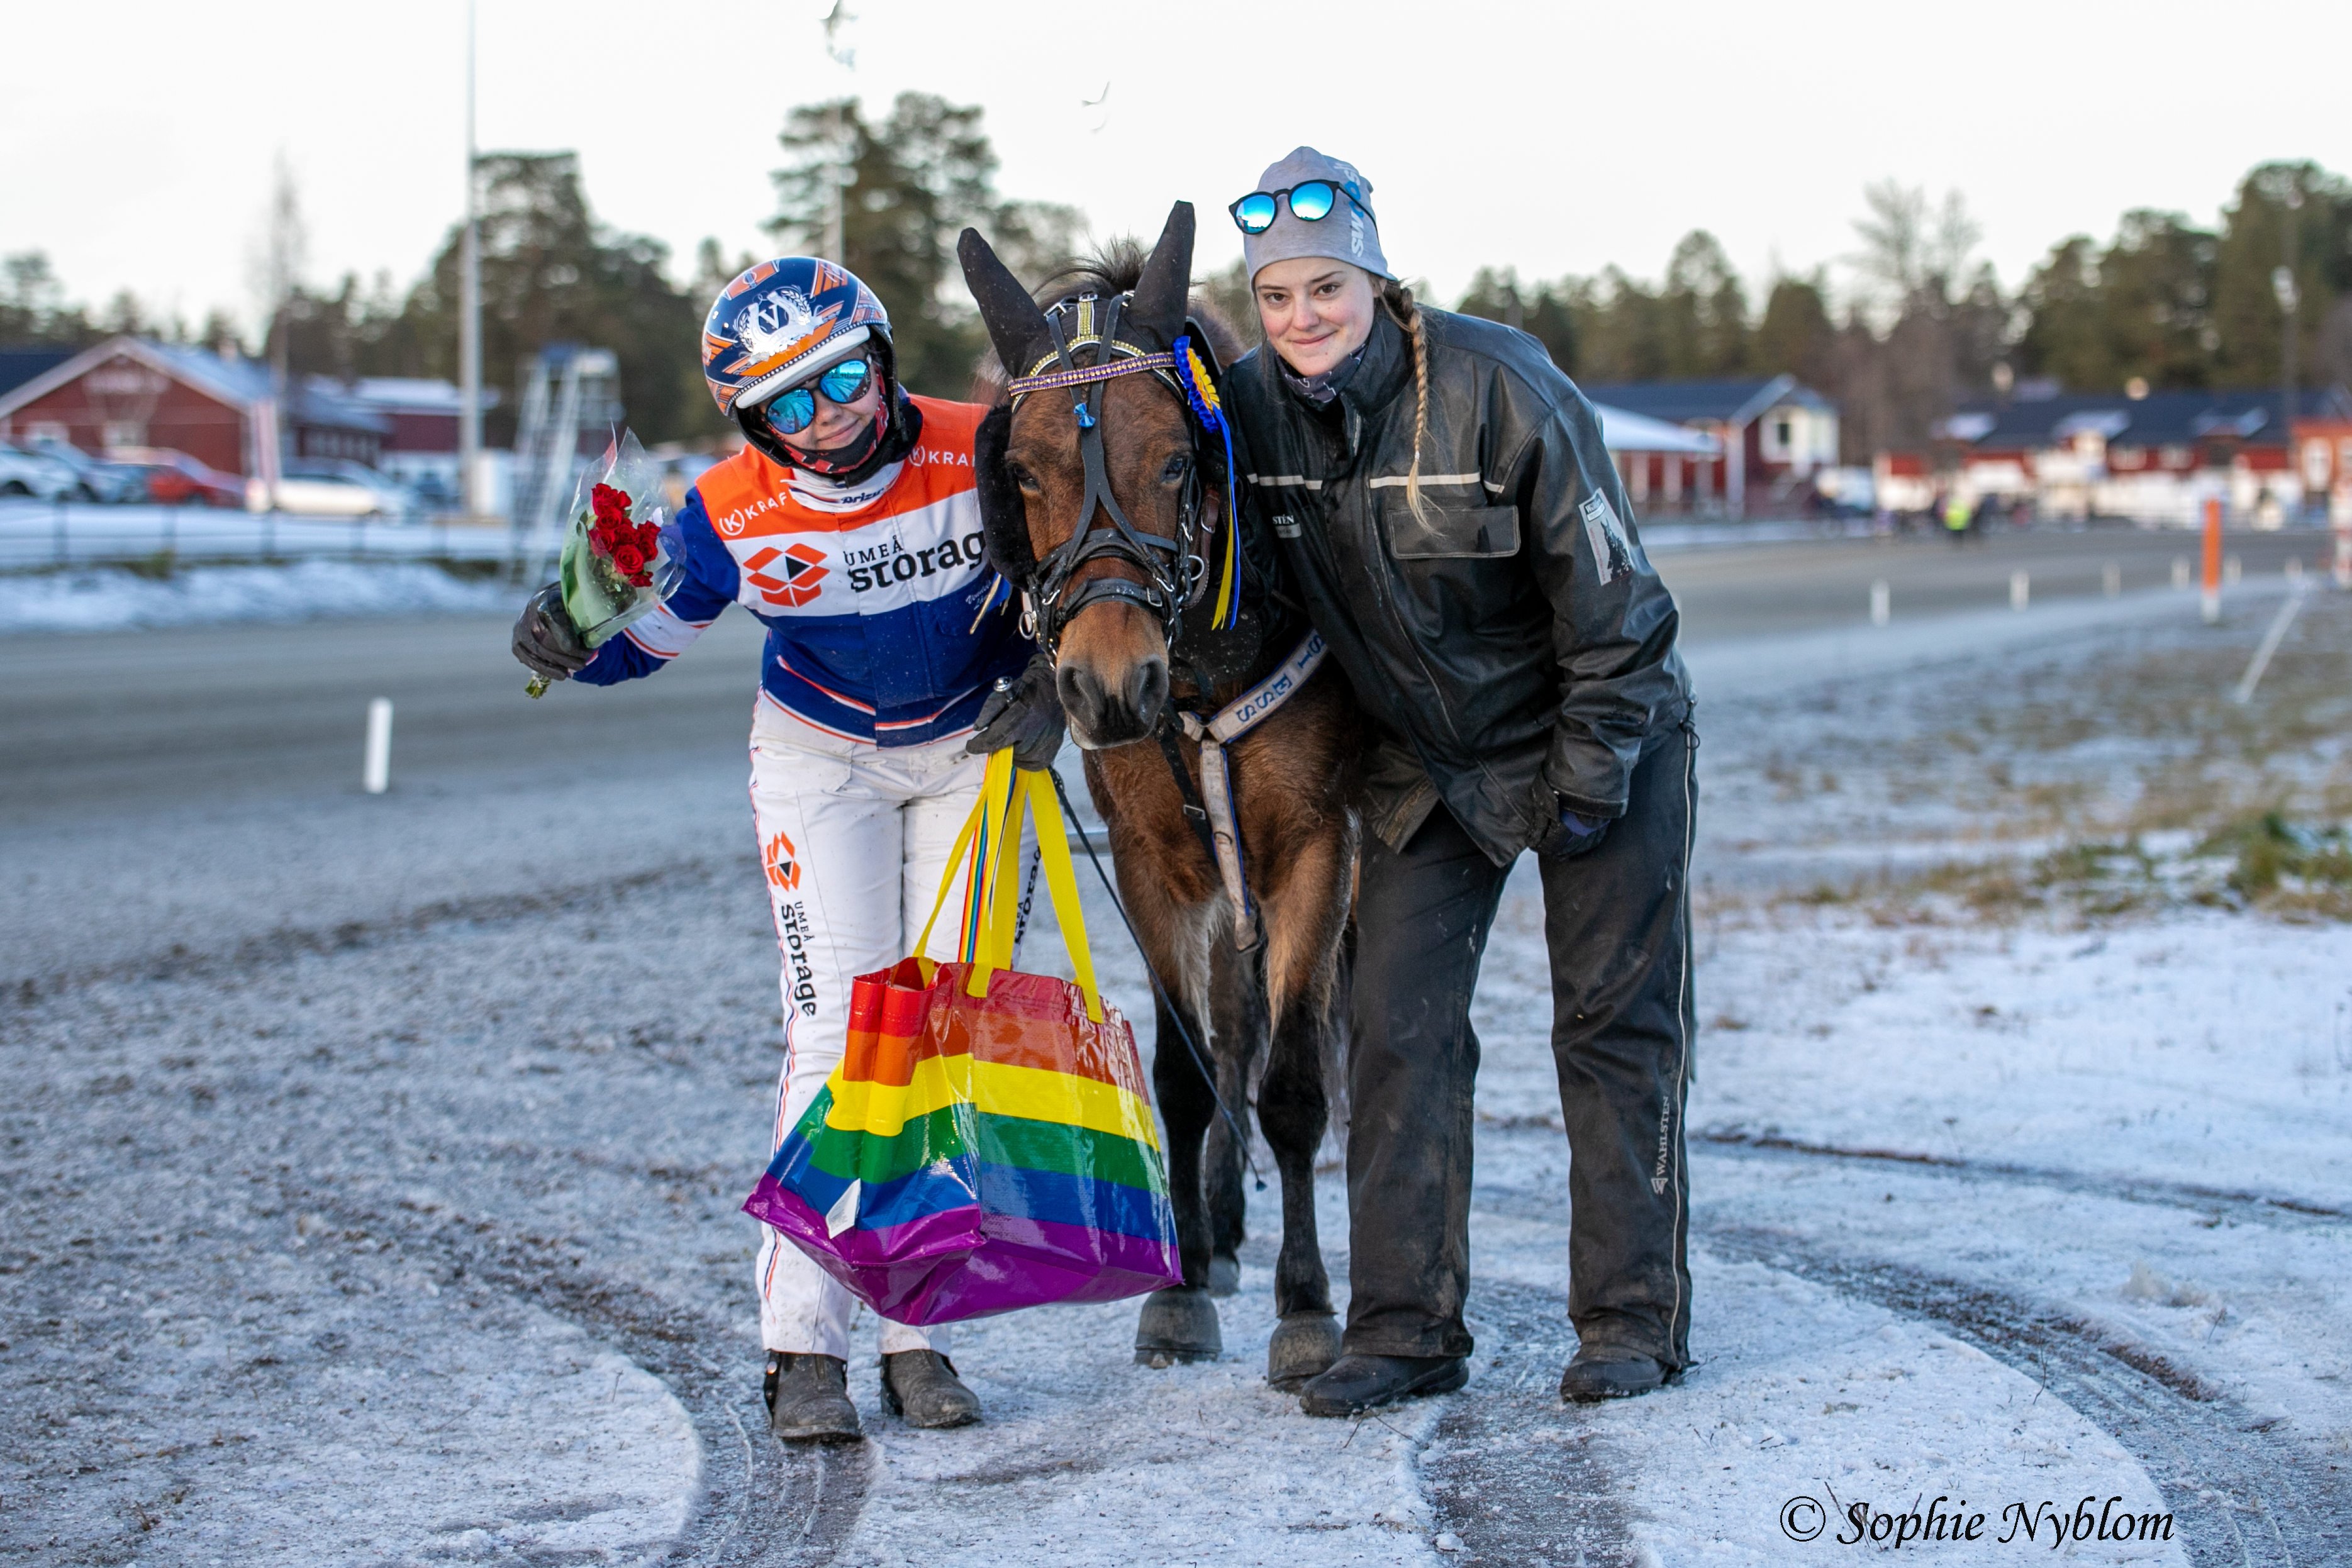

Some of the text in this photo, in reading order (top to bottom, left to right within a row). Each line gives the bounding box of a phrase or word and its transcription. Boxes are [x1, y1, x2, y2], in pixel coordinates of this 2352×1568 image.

[929, 450, 975, 467] KRA
[844, 535, 903, 566] UMEÅ
[794, 901, 815, 942] UMEÅ
[781, 904, 817, 1016] storage
